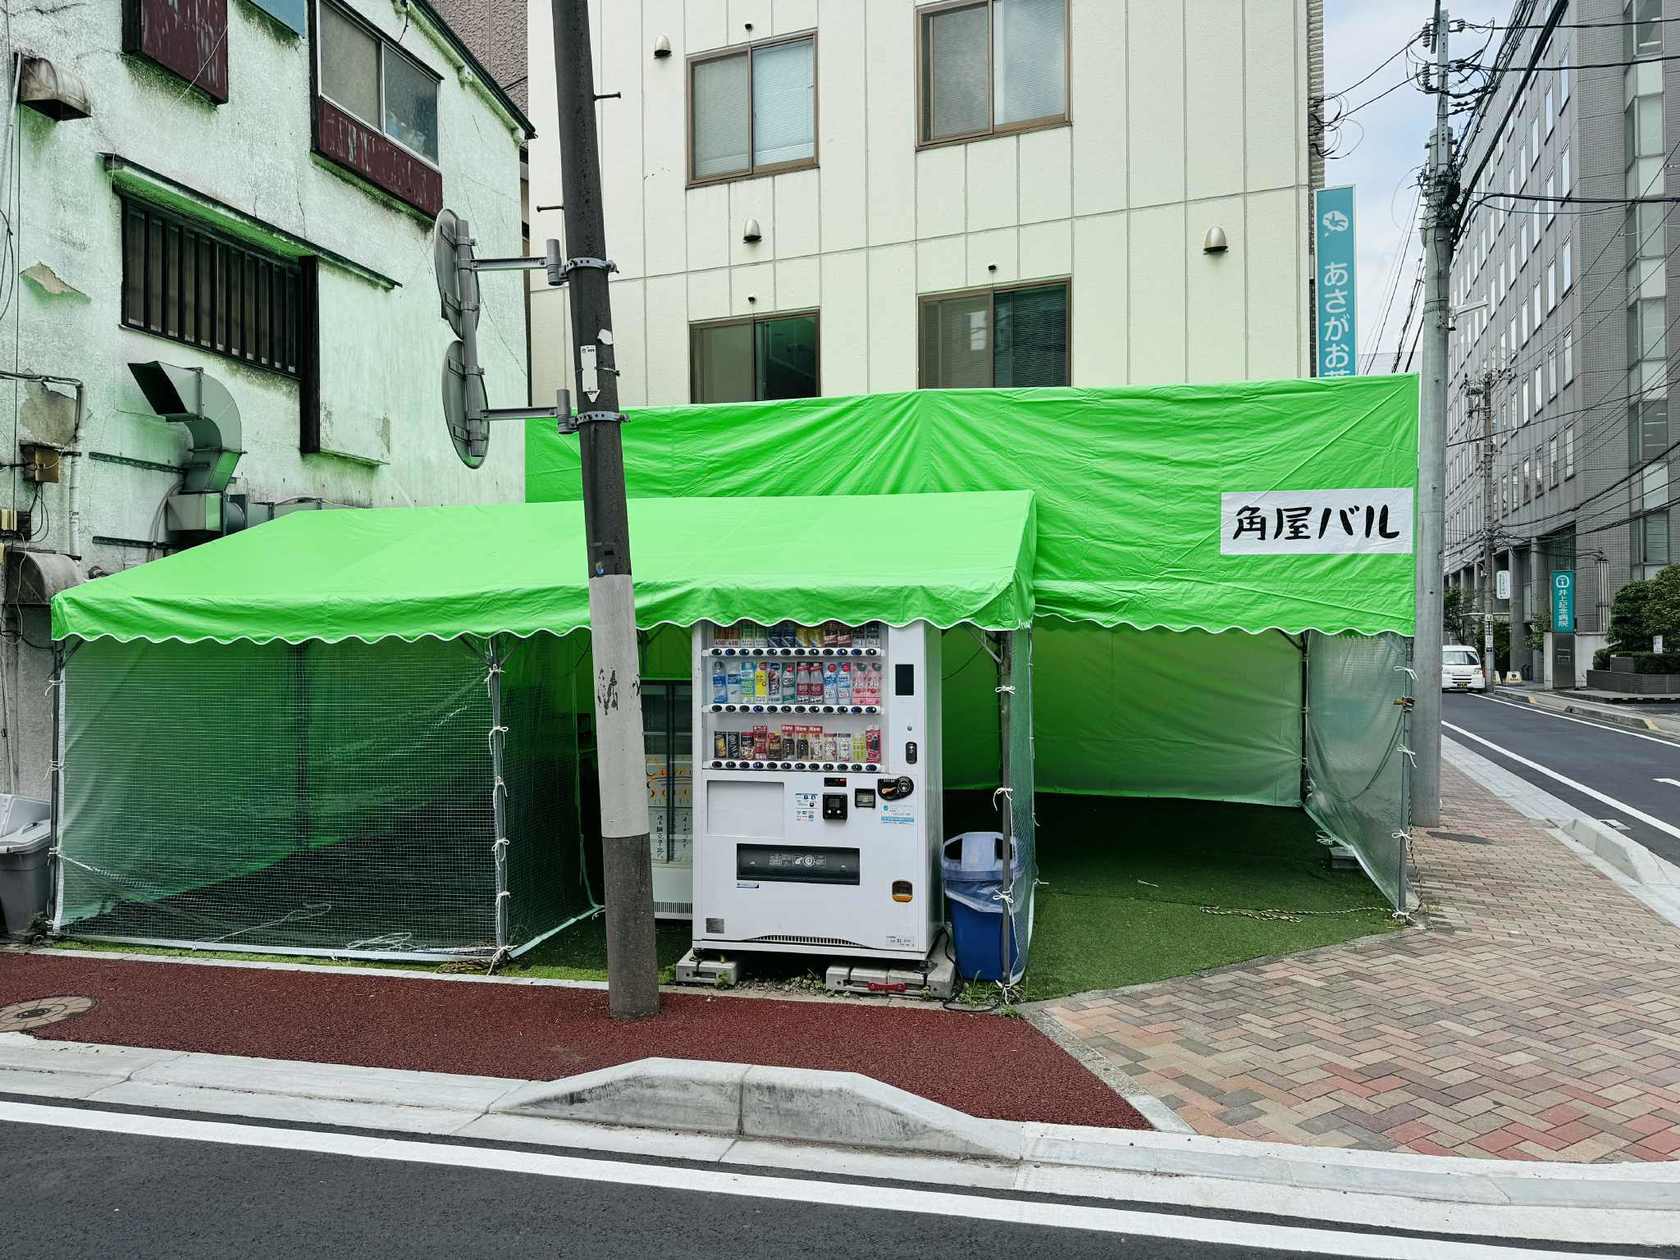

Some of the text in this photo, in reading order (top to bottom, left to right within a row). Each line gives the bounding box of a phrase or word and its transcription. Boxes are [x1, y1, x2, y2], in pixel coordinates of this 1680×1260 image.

[1324, 261, 1350, 377] あさがお
[1232, 504, 1400, 541] 角屋バル
